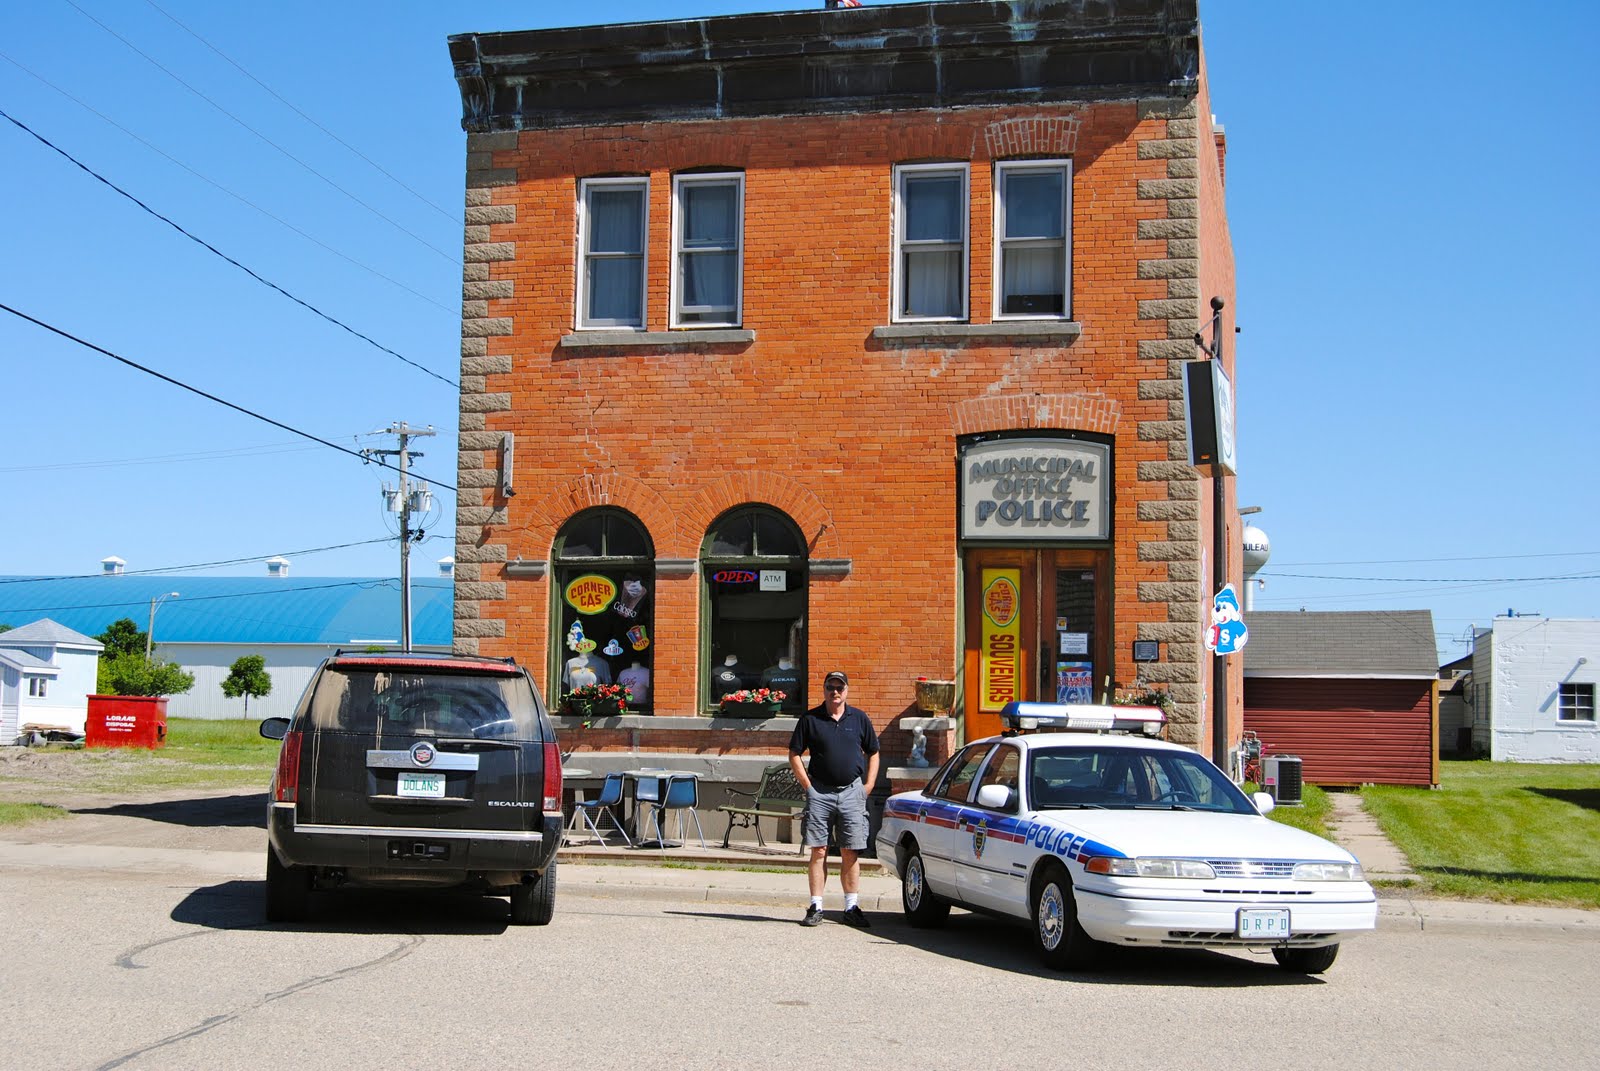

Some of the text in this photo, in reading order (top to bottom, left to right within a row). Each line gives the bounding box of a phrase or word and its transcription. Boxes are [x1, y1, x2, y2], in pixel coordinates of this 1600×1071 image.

[969, 456, 1097, 481] MUNICIPAL
[993, 478, 1072, 497] OFFICE
[975, 500, 1090, 525] POLICE
[716, 571, 755, 582] OPEN
[570, 581, 611, 599] CORNER
[580, 593, 602, 607] GAS
[989, 591, 1001, 612] GAS
[998, 582, 1013, 621] CORNER
[1220, 629, 1230, 644] S
[989, 634, 1014, 703] SOUVENIRS
[403, 779, 439, 792] DOLANS
[1025, 823, 1086, 860] POLICE
